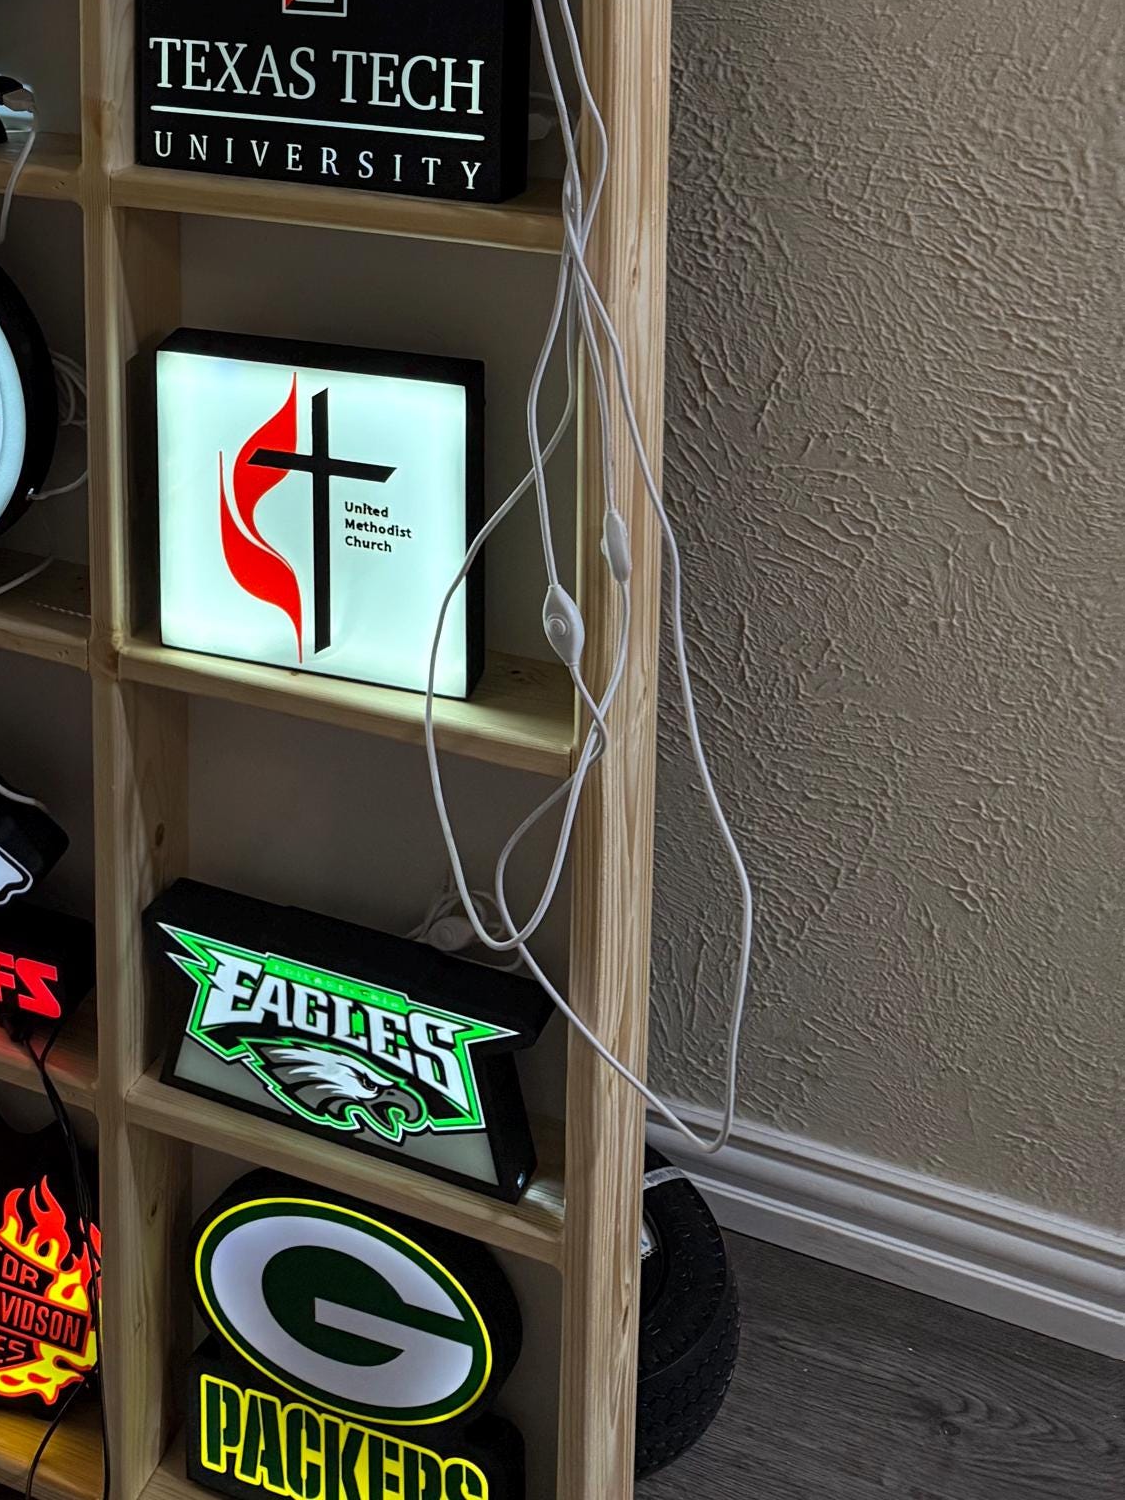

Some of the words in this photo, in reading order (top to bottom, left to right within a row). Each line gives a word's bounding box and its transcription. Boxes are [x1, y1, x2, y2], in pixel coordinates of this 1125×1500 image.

[149, 37, 317, 100] TEXAS
[332, 50, 485, 115] TECH
[153, 130, 482, 191] UNIVERSITY
[344, 500, 389, 518] United
[344, 518, 413, 539] Methodist
[344, 535, 392, 553] Church
[200, 948, 471, 1110] EAGLES
[210, 1215, 473, 1408] G
